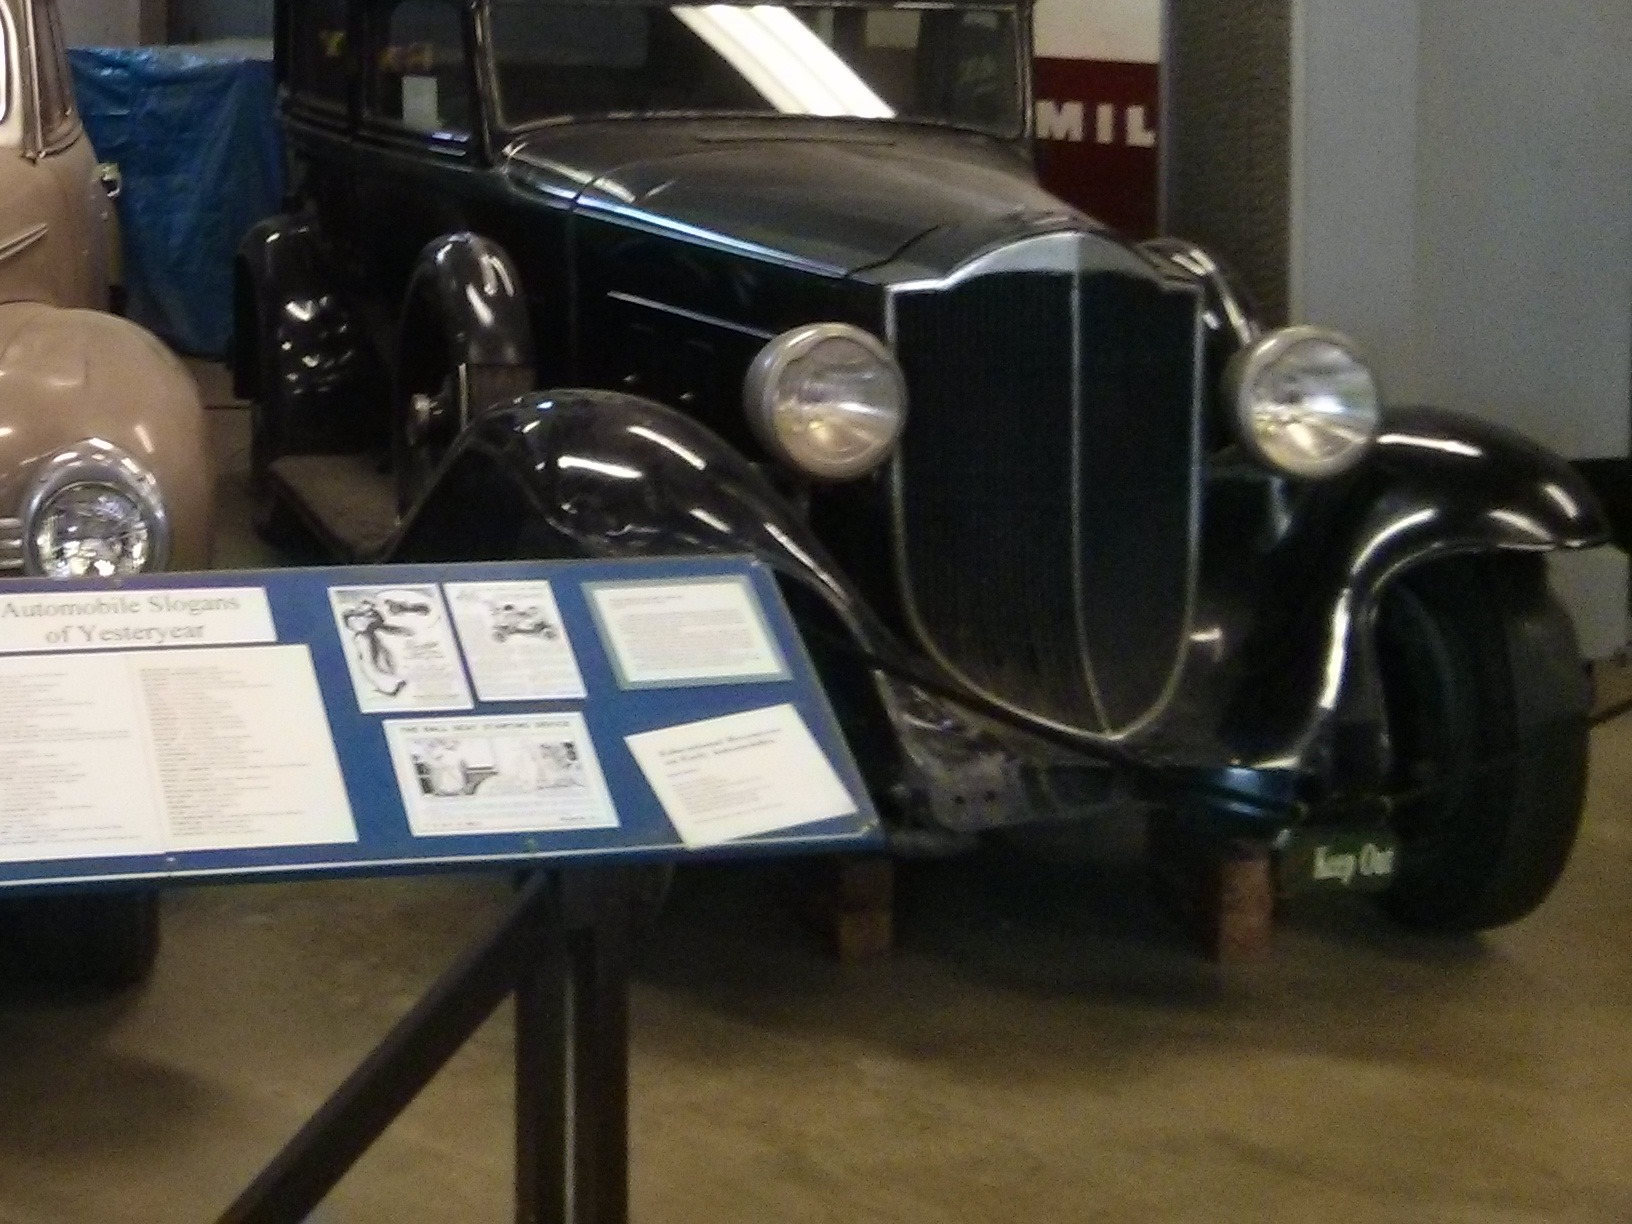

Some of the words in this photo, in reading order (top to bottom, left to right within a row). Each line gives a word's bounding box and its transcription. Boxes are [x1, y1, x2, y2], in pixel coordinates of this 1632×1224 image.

[1, 596, 139, 619] Automobile
[147, 594, 241, 616] Slogans
[45, 626, 71, 644] of
[78, 623, 205, 645] Yesteryear
